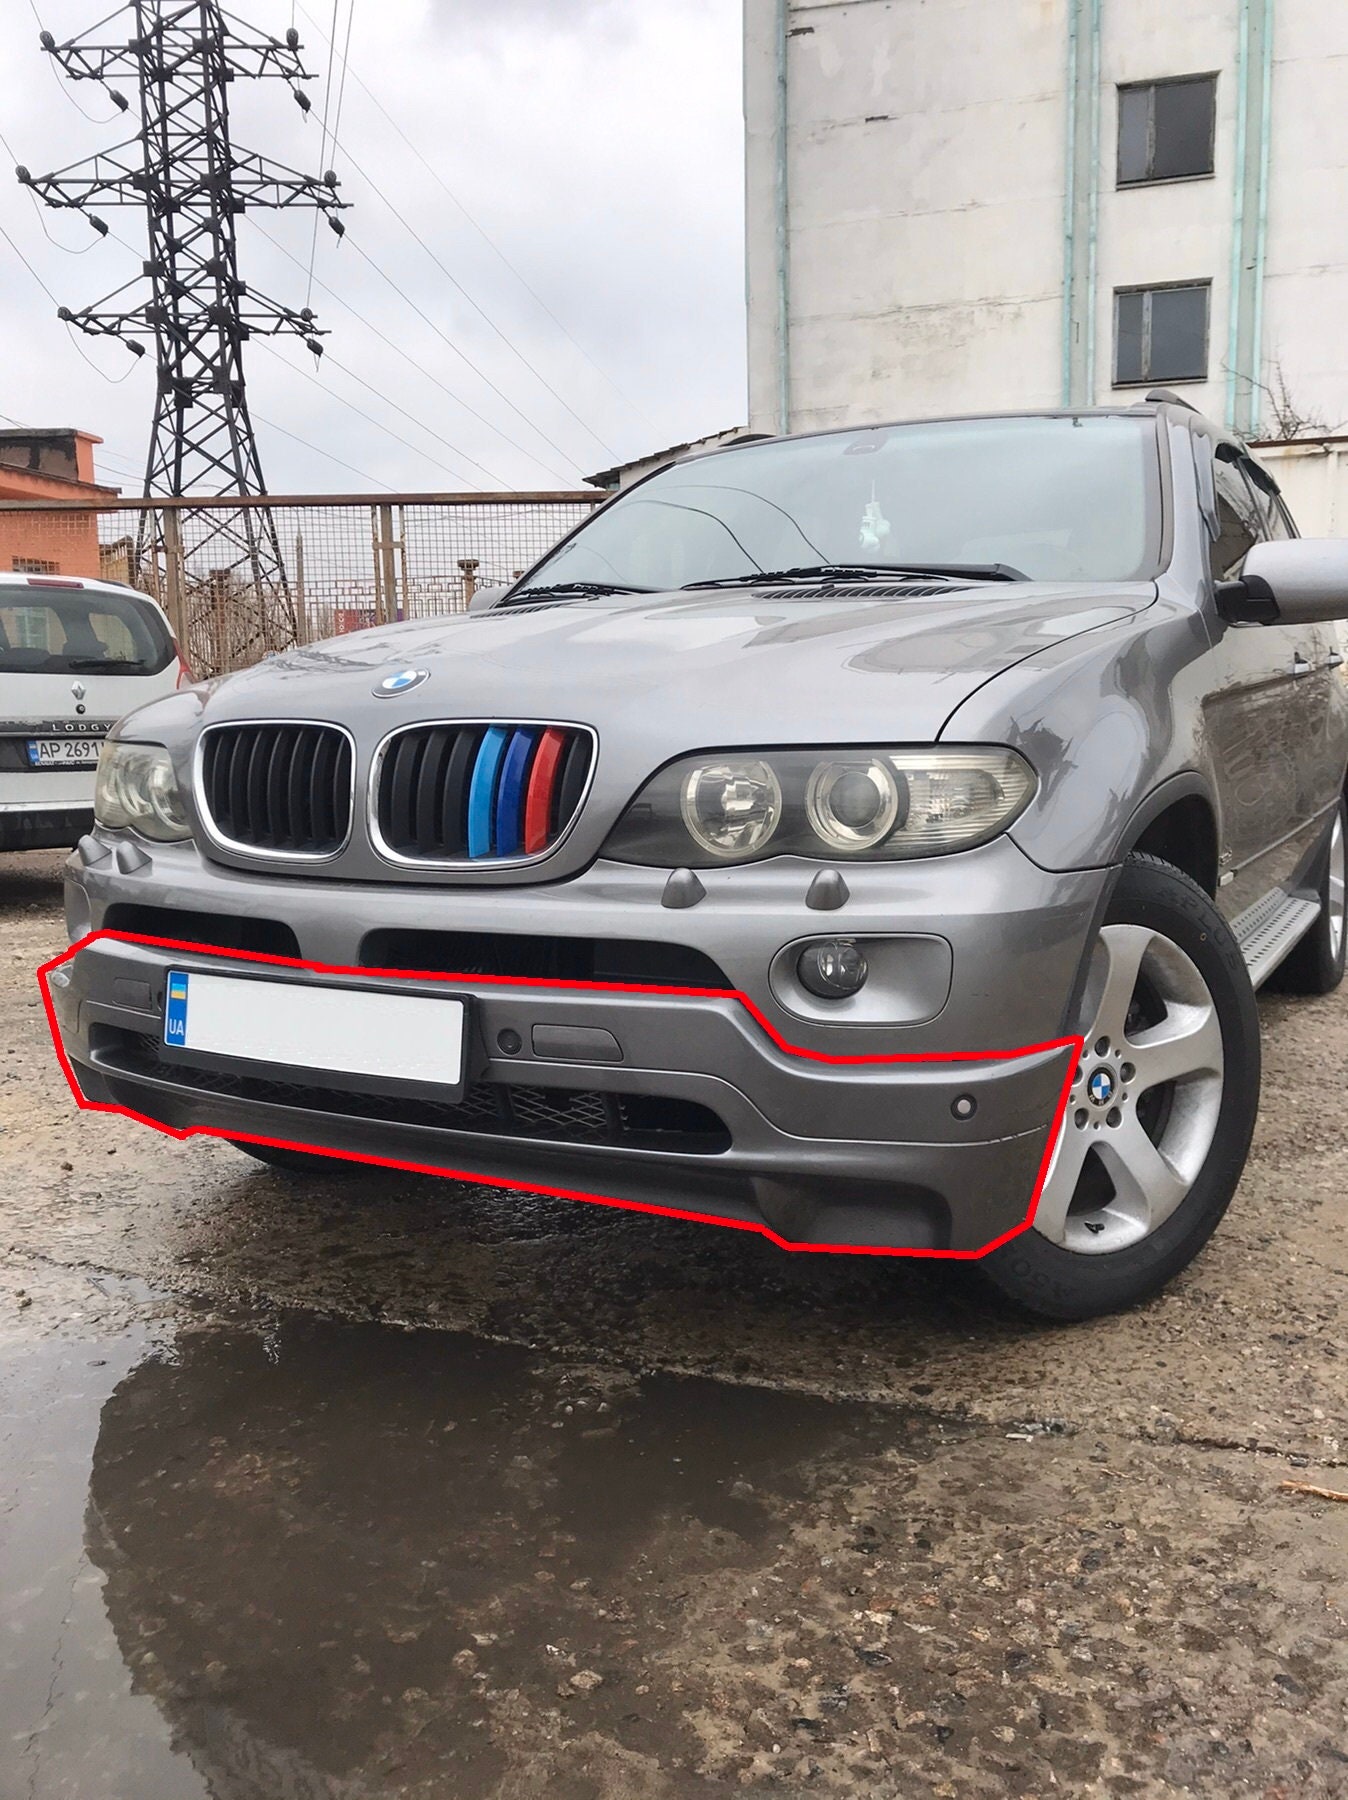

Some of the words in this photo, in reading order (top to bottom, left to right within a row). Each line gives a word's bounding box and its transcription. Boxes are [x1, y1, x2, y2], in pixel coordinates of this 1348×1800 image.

[52, 723, 111, 732] LODGY
[40, 742, 61, 758] AP
[64, 741, 99, 758] 2691
[169, 1018, 185, 1036] UA
